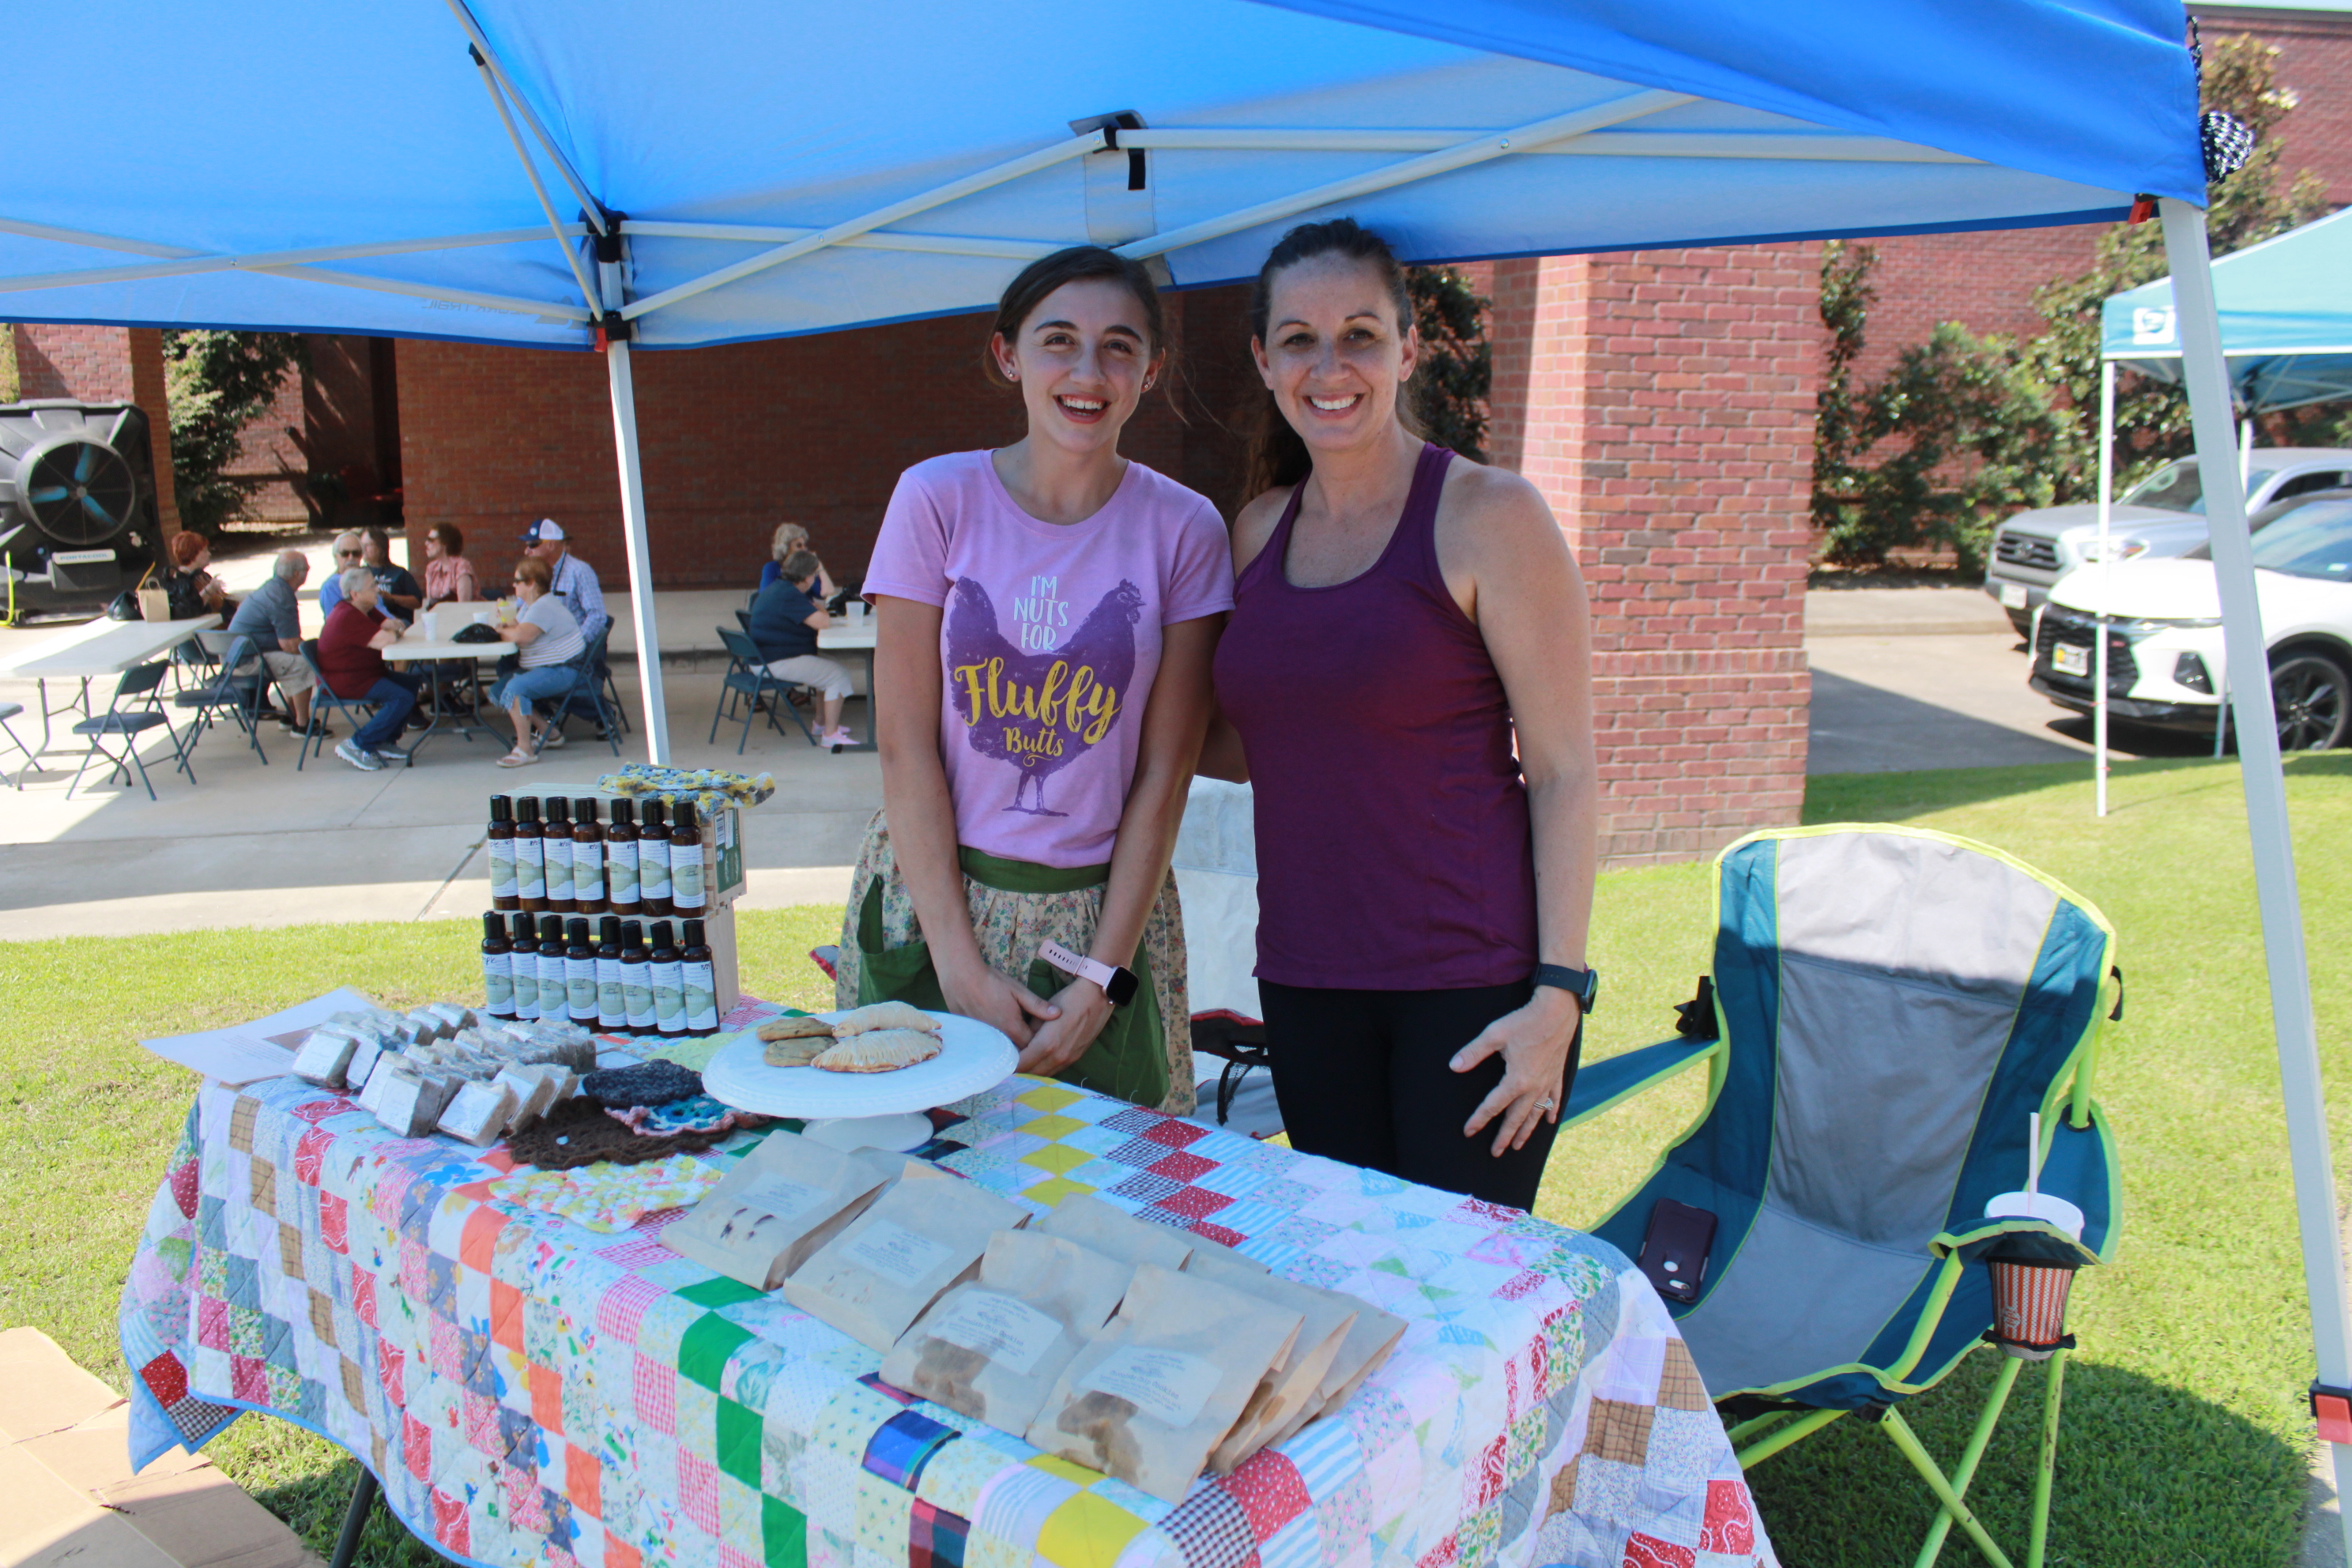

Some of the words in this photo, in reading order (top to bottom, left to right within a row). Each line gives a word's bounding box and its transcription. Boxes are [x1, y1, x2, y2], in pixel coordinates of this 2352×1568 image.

[1031, 575, 1057, 599] I'M
[1013, 597, 1069, 627] NUTS
[1020, 623, 1057, 650] FOR
[954, 656, 1123, 744] Fluffy
[1003, 727, 1064, 756] Butts
[999, 1330, 1024, 1347] Cookies
[1152, 1381, 1179, 1400] Cookies
